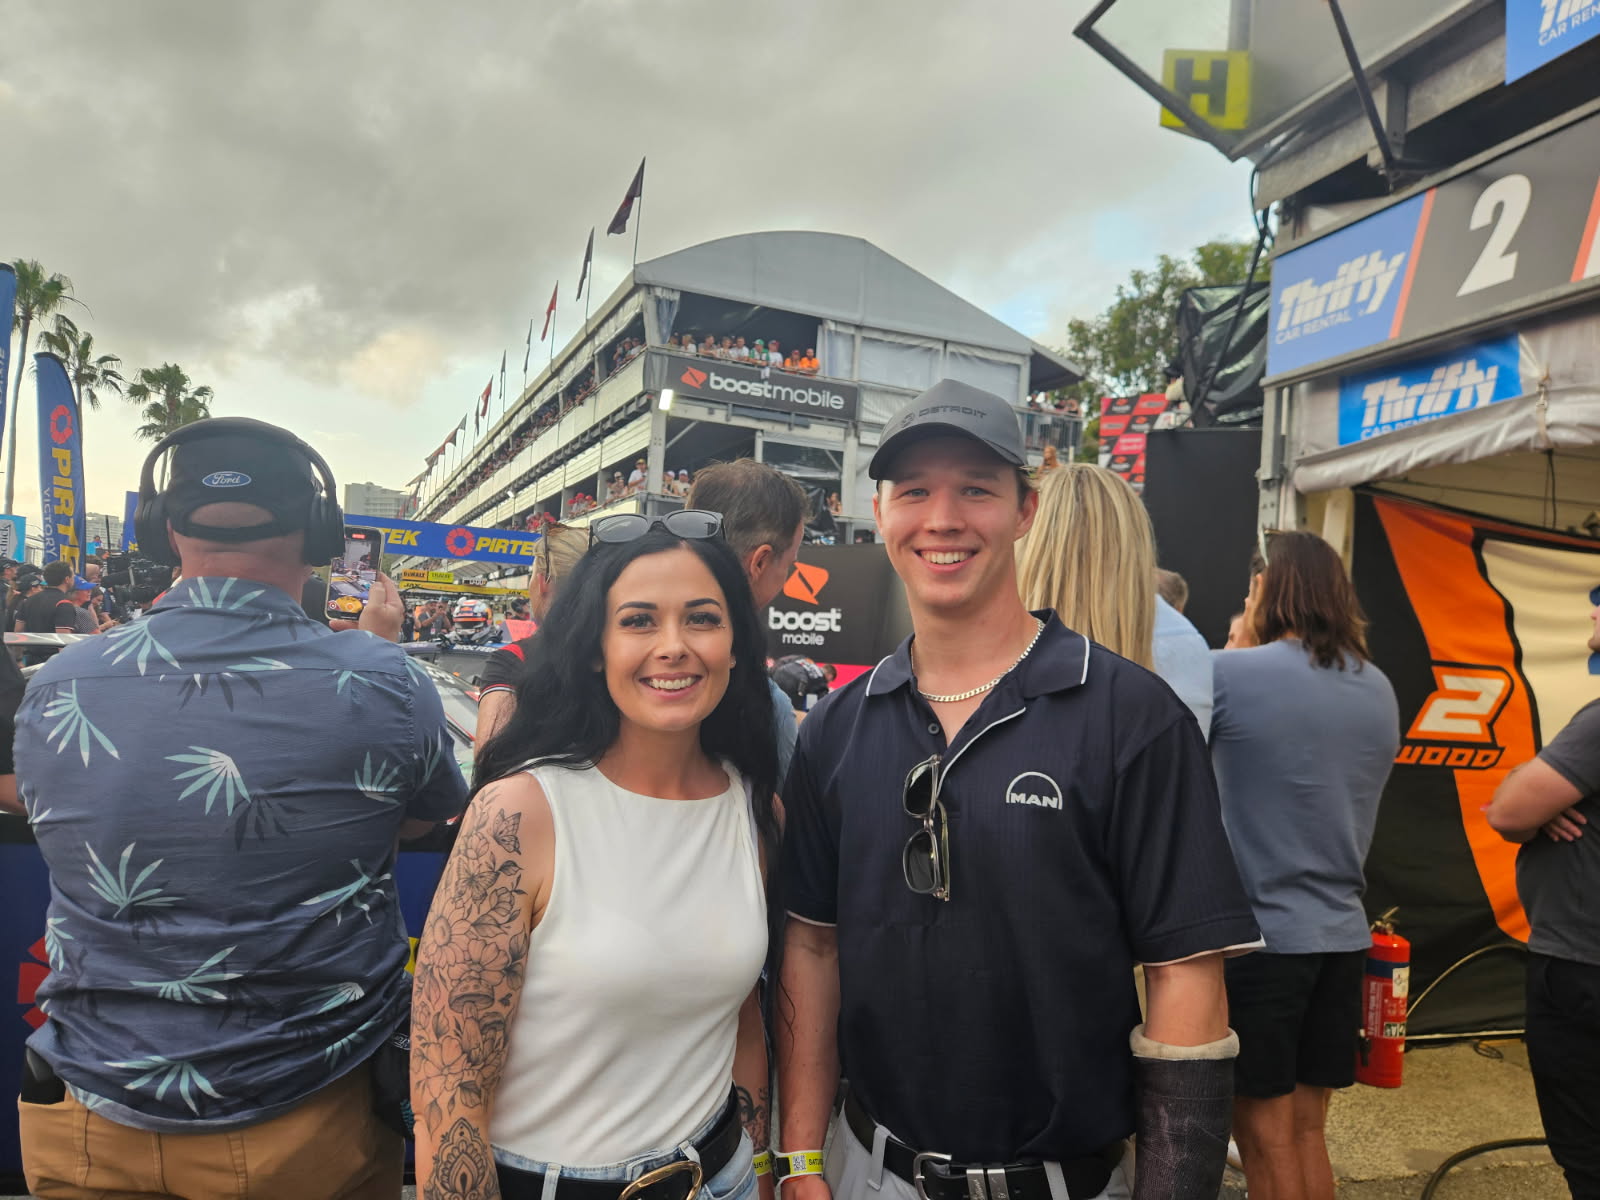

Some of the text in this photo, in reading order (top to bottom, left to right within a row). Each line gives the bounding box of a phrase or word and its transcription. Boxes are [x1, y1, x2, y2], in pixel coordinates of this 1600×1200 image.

[1539, 21, 1567, 47] CAR
[1173, 58, 1230, 117] H
[1456, 174, 1532, 298] 2
[1277, 250, 1406, 331] Thrifty
[1276, 310, 1352, 344] CAR RENTAL
[1362, 359, 1498, 428] Thrifty
[918, 405, 987, 419] DETROIT
[211, 473, 241, 485] Ford
[43, 487, 58, 557] VICTORY
[768, 606, 842, 632] boost
[782, 632, 825, 646] mobile
[1417, 675, 1506, 734] 2
[1010, 792, 1058, 809] MAN
